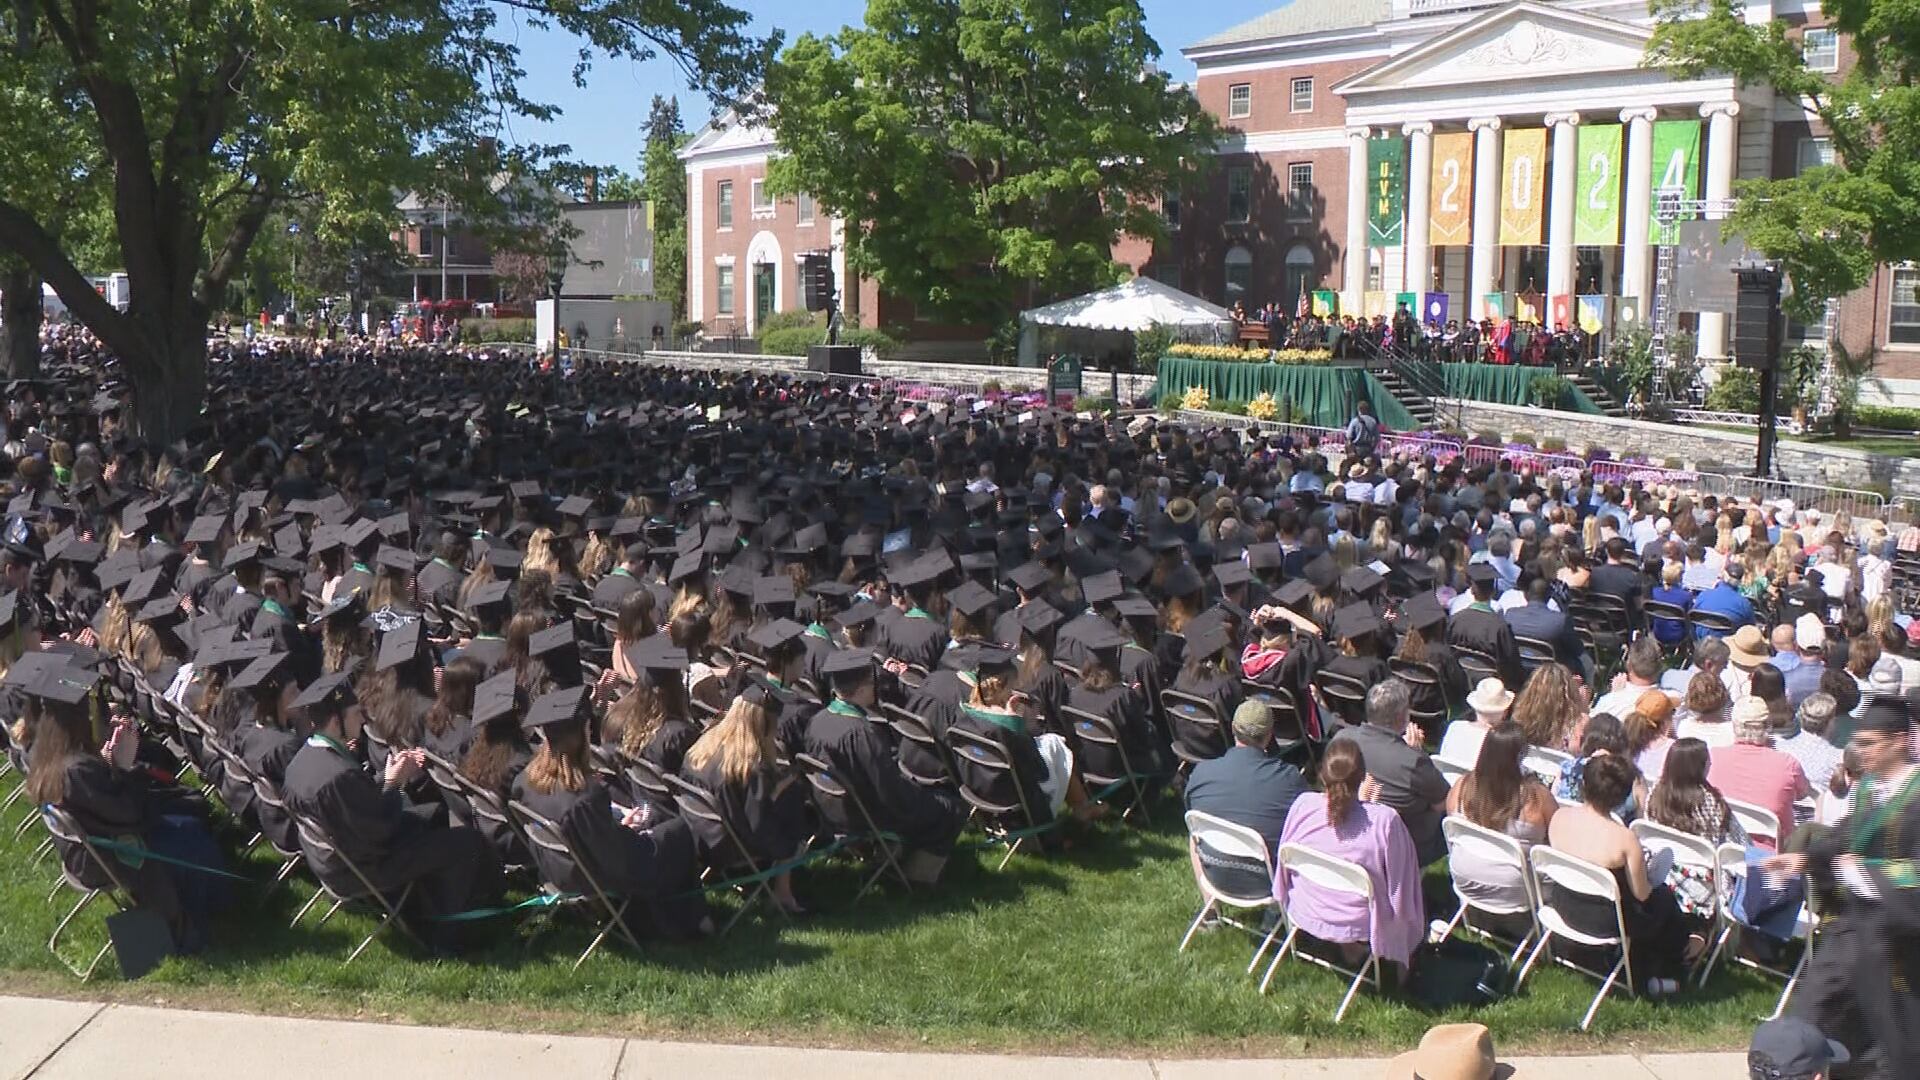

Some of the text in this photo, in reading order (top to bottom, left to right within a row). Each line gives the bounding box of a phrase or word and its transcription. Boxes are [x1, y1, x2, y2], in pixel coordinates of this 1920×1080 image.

[1379, 161, 1389, 215] UVM
[1440, 158, 1460, 213] 2
[1588, 151, 1610, 210] 2
